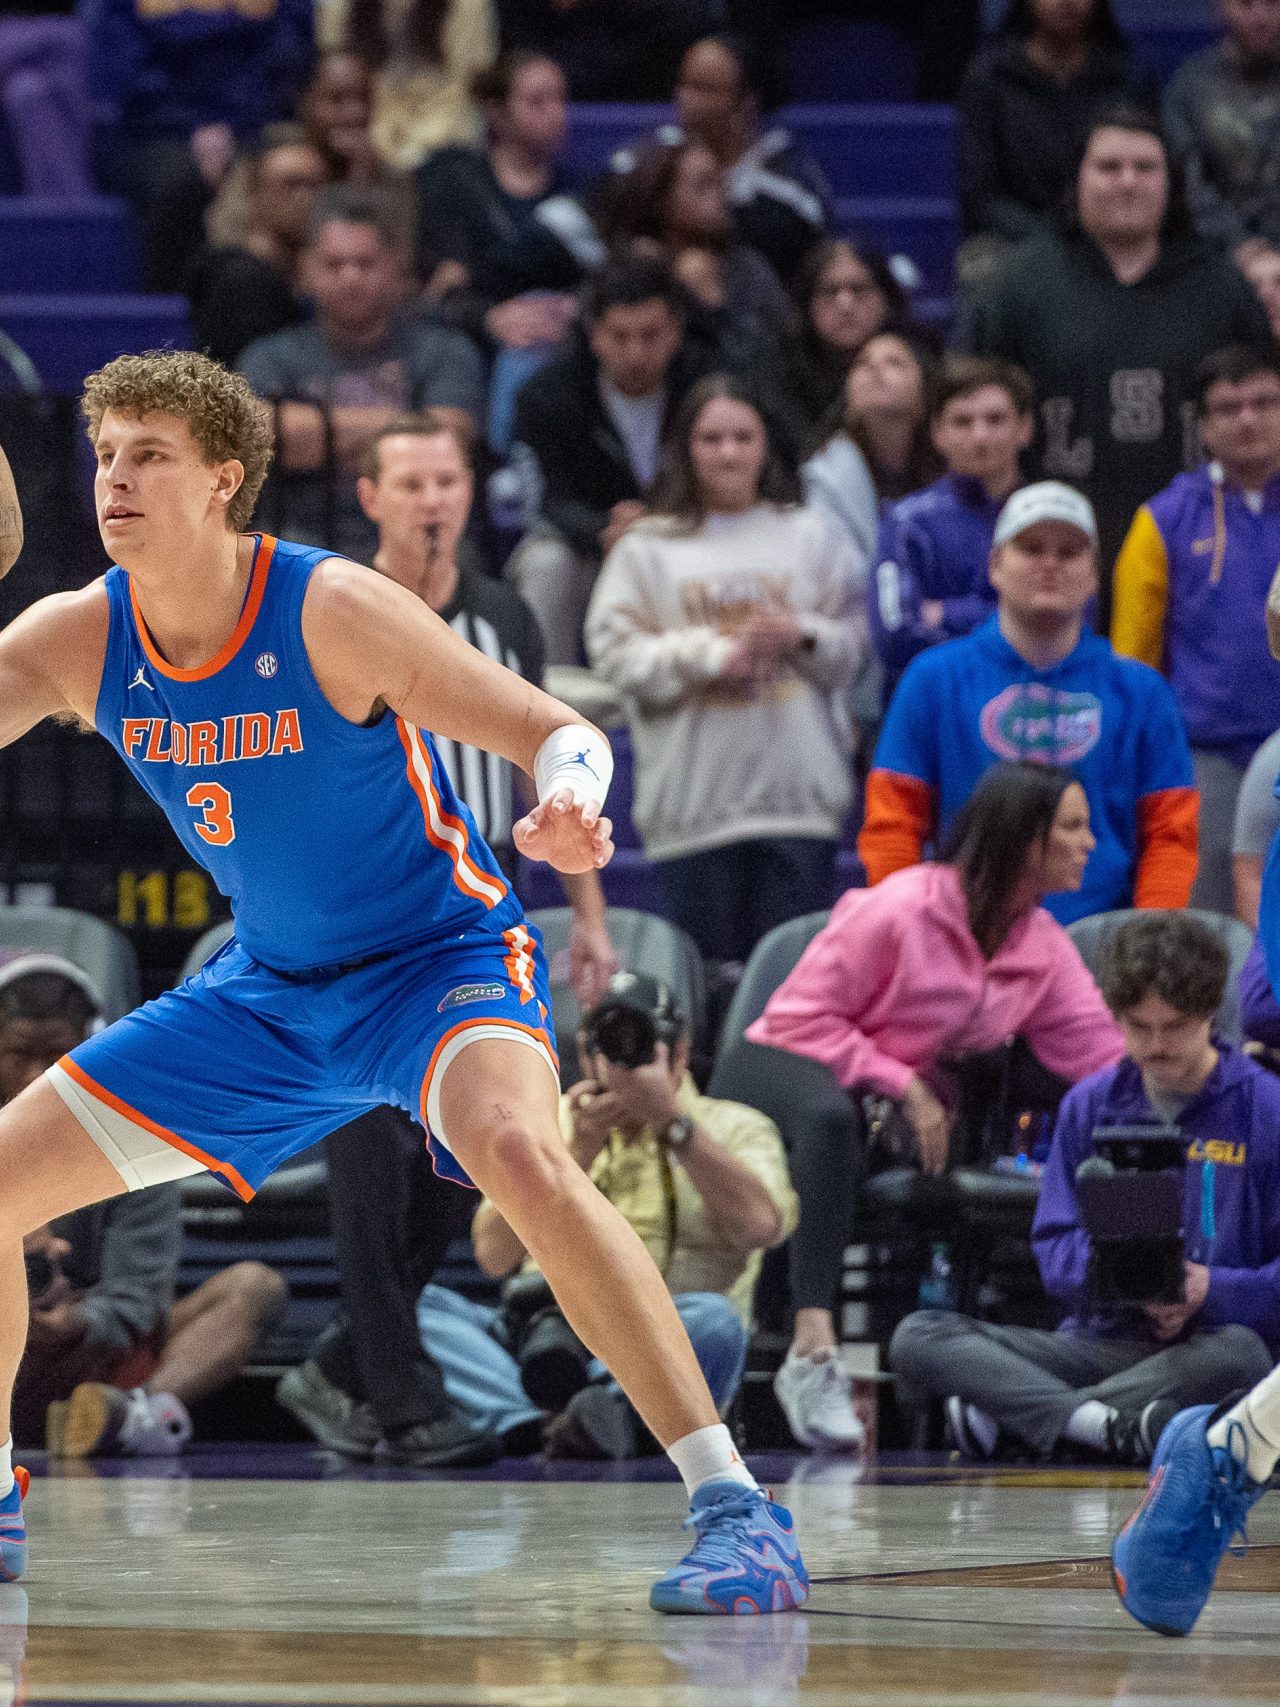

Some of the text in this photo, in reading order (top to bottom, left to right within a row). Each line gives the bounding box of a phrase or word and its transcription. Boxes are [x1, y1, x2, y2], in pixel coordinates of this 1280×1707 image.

[257, 654, 276, 676] SEC
[121, 707, 304, 767] FLORIDA
[186, 782, 235, 847] 3
